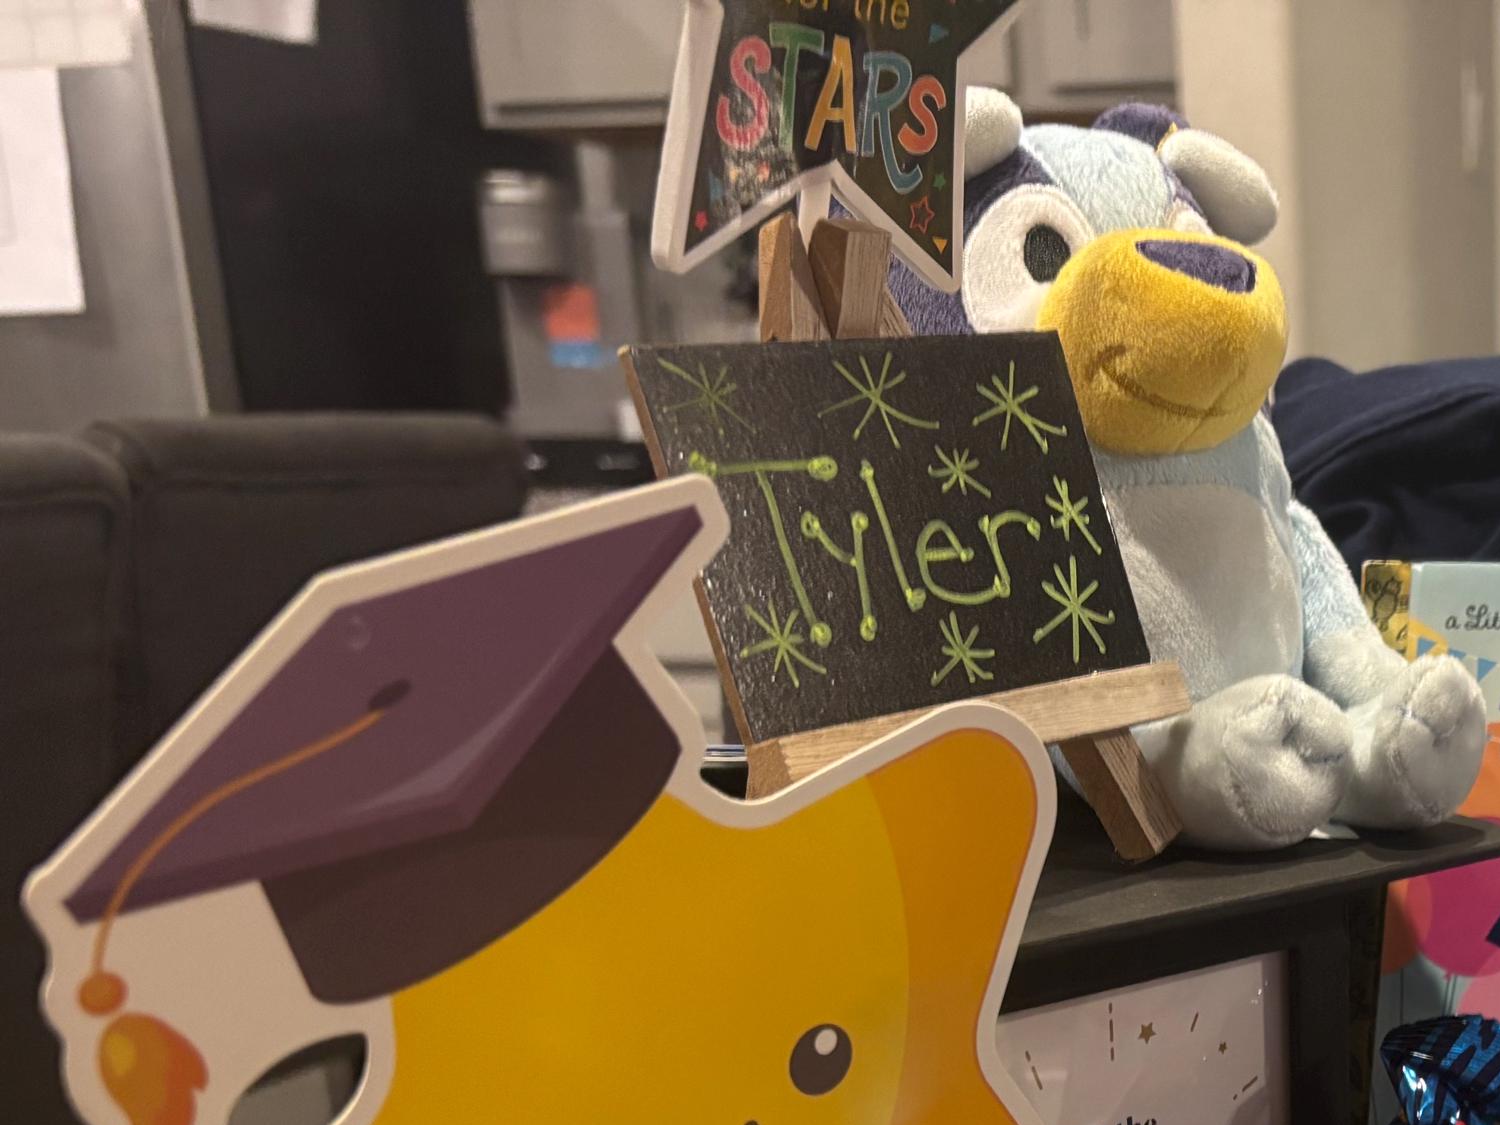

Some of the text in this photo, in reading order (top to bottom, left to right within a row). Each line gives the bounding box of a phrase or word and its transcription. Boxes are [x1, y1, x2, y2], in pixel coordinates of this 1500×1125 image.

[715, 22, 947, 194] STARS
[689, 451, 1041, 647] Tyler
[1445, 614, 1461, 630] a
